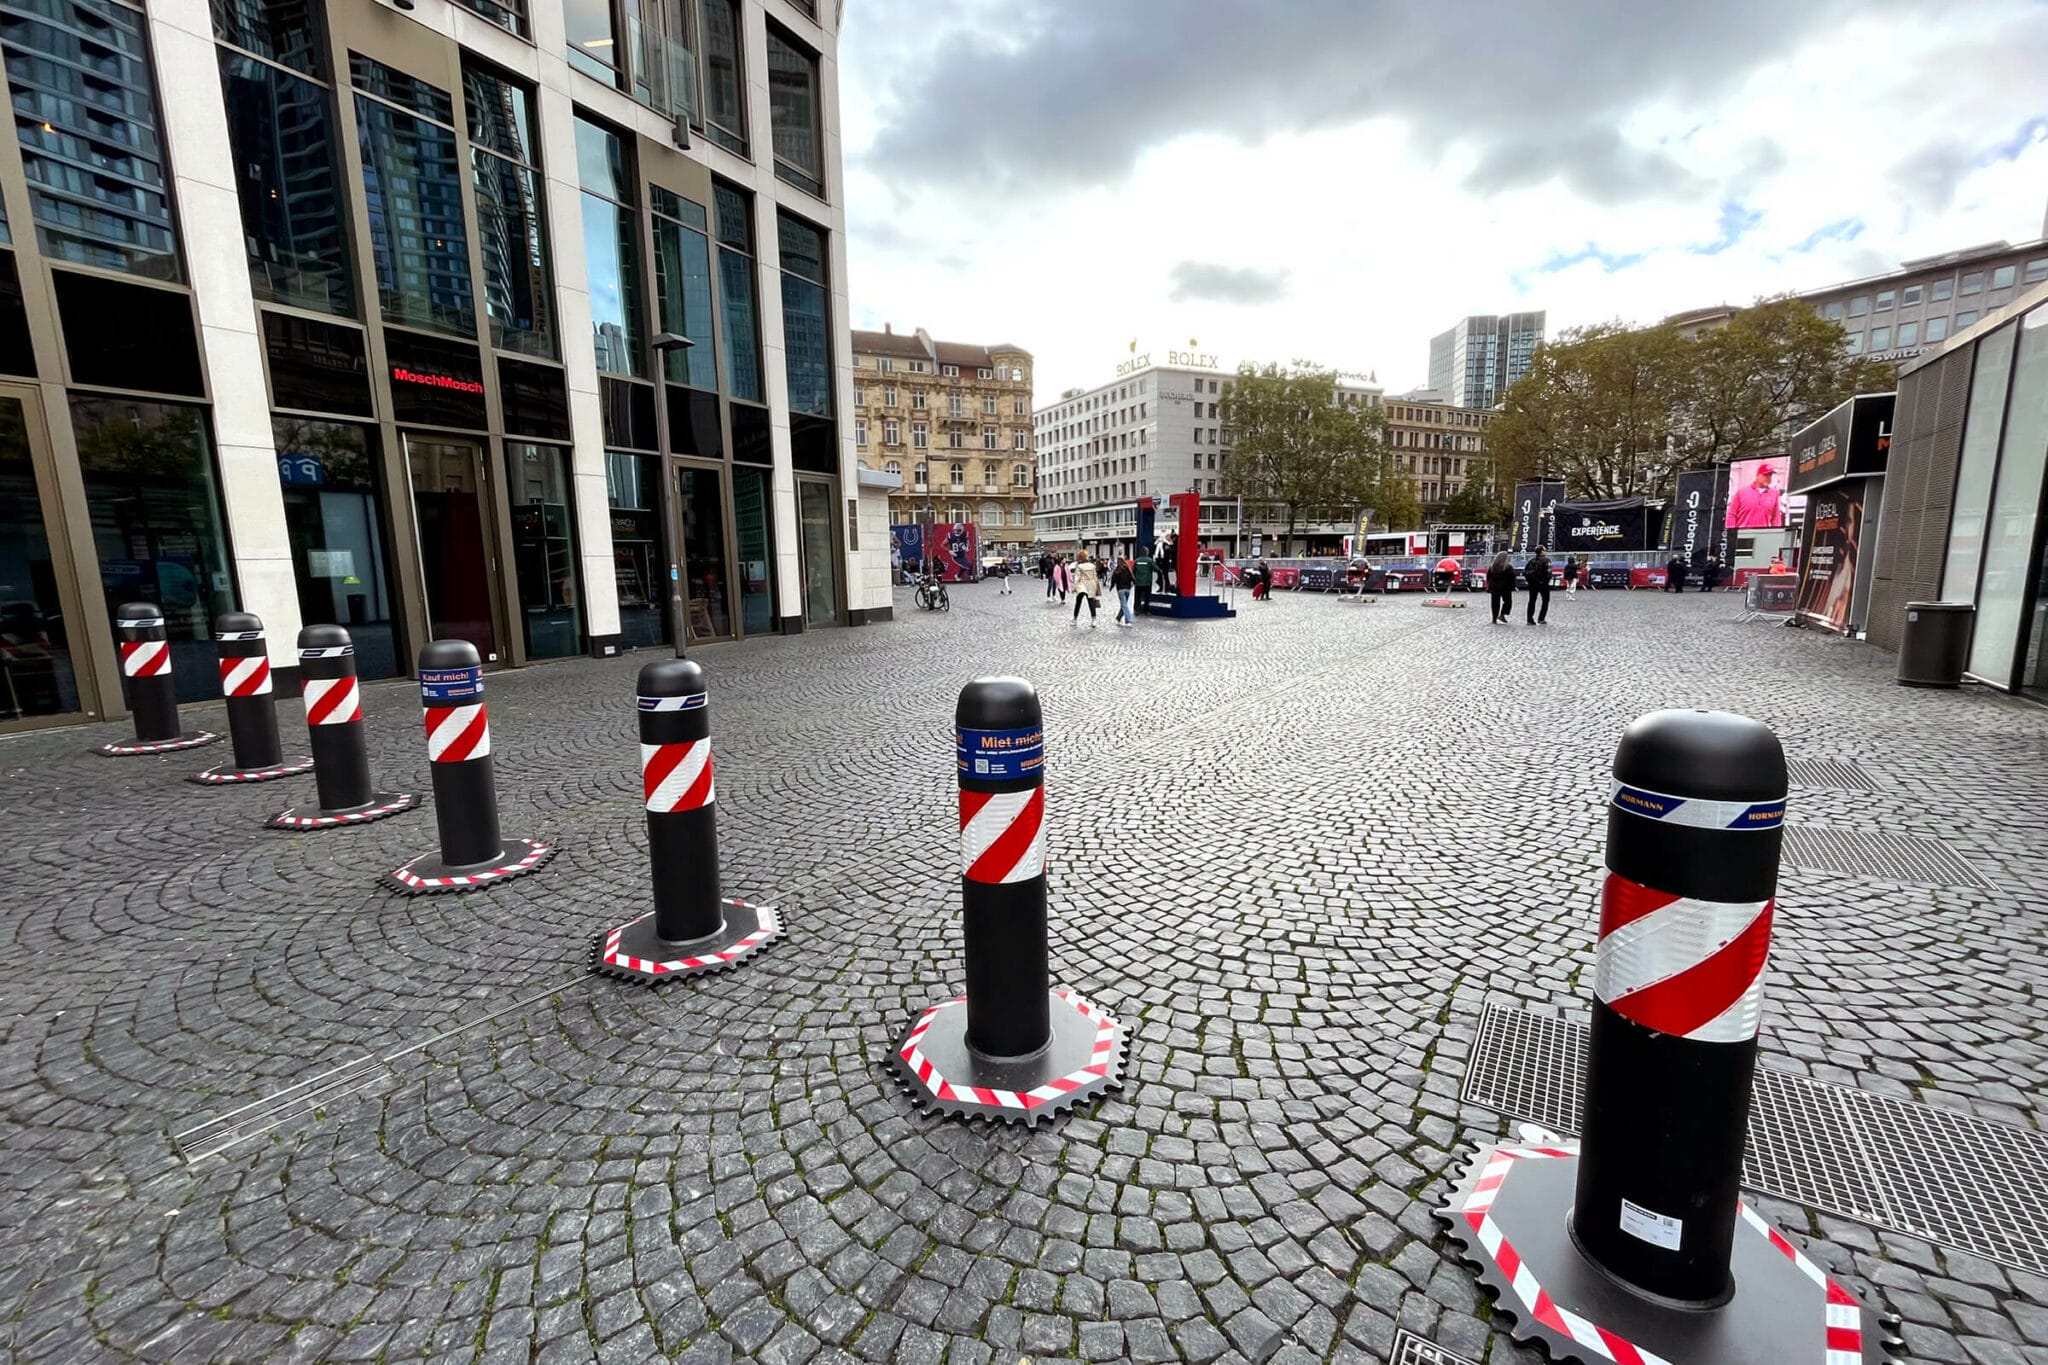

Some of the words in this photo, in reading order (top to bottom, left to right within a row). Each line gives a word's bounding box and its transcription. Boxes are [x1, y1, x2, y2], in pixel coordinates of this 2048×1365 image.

[1116, 353, 1151, 377] ROLEX
[1168, 351, 1218, 369] ROLEX
[394, 368, 483, 393] MoschMosch
[1571, 525, 1620, 536] EXPERIENCE
[422, 674, 440, 682] Kauf
[443, 672, 469, 681] mich!
[981, 736, 1011, 748] Miet
